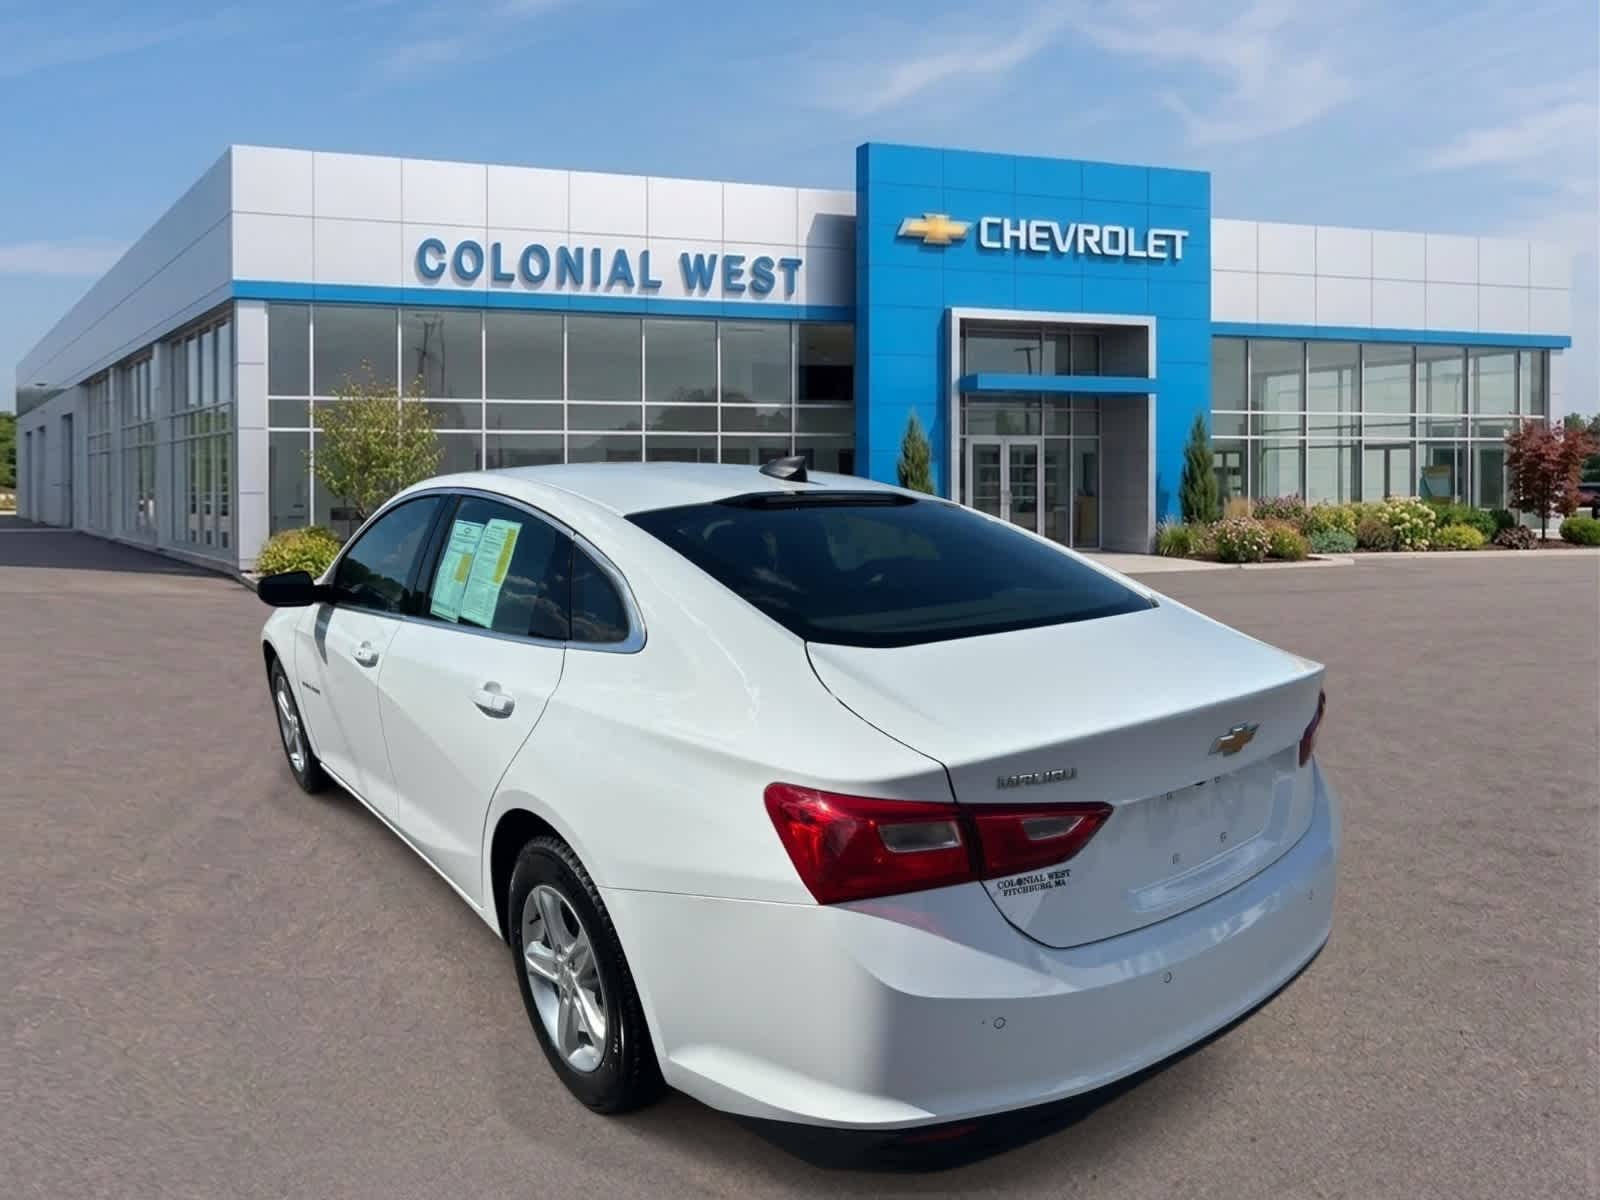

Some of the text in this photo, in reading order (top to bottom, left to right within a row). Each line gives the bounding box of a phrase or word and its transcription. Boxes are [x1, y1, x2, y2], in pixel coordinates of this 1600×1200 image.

[979, 216, 1190, 260] CHEVROLET
[415, 238, 803, 296] COLONIAL WEST
[997, 868, 1071, 890] COLONIAL WEST
[1054, 878, 1067, 888] MA
